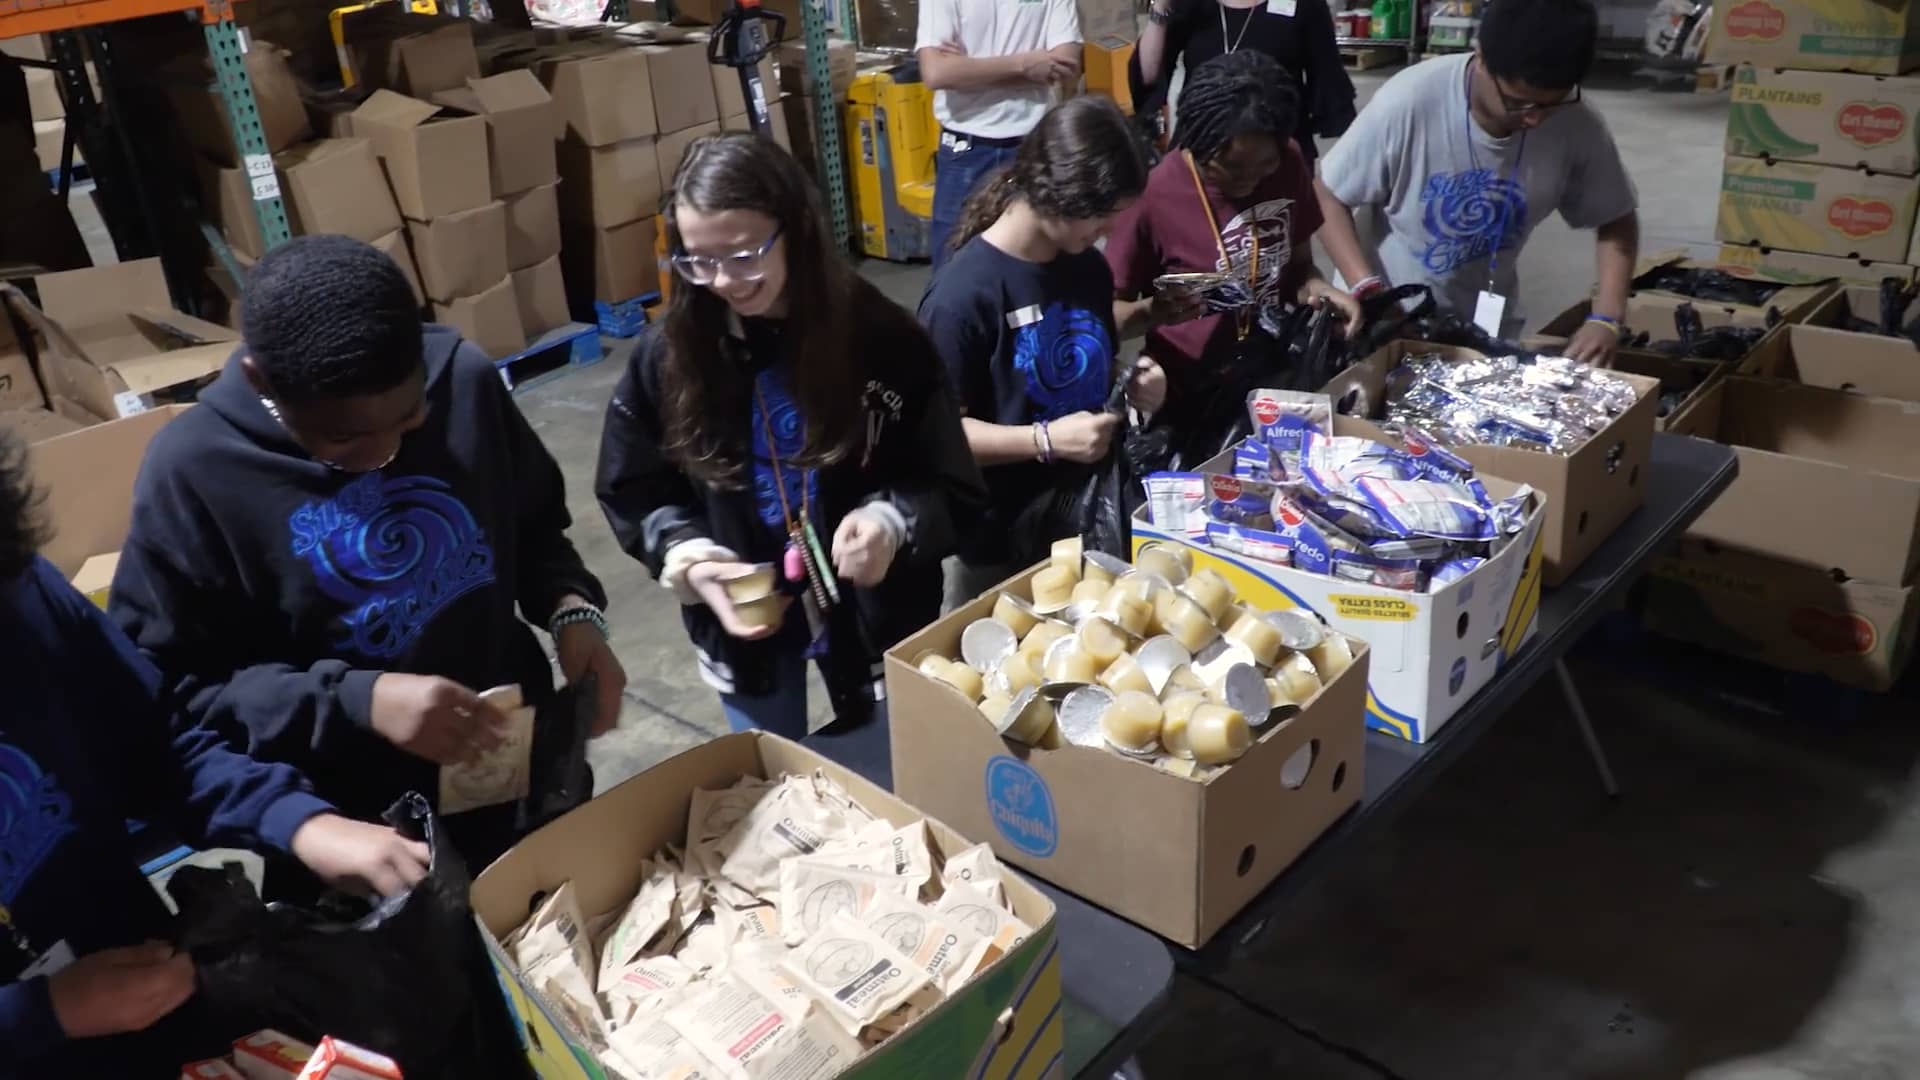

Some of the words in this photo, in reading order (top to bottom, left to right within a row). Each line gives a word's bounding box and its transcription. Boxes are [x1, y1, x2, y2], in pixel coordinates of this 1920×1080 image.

[1739, 86, 1823, 105] PLANTAINS
[1266, 426, 1304, 438] Alfred
[1338, 597, 1373, 609] EXTRA
[1375, 599, 1407, 610] CLASS
[847, 966, 902, 1010] Oatmeal
